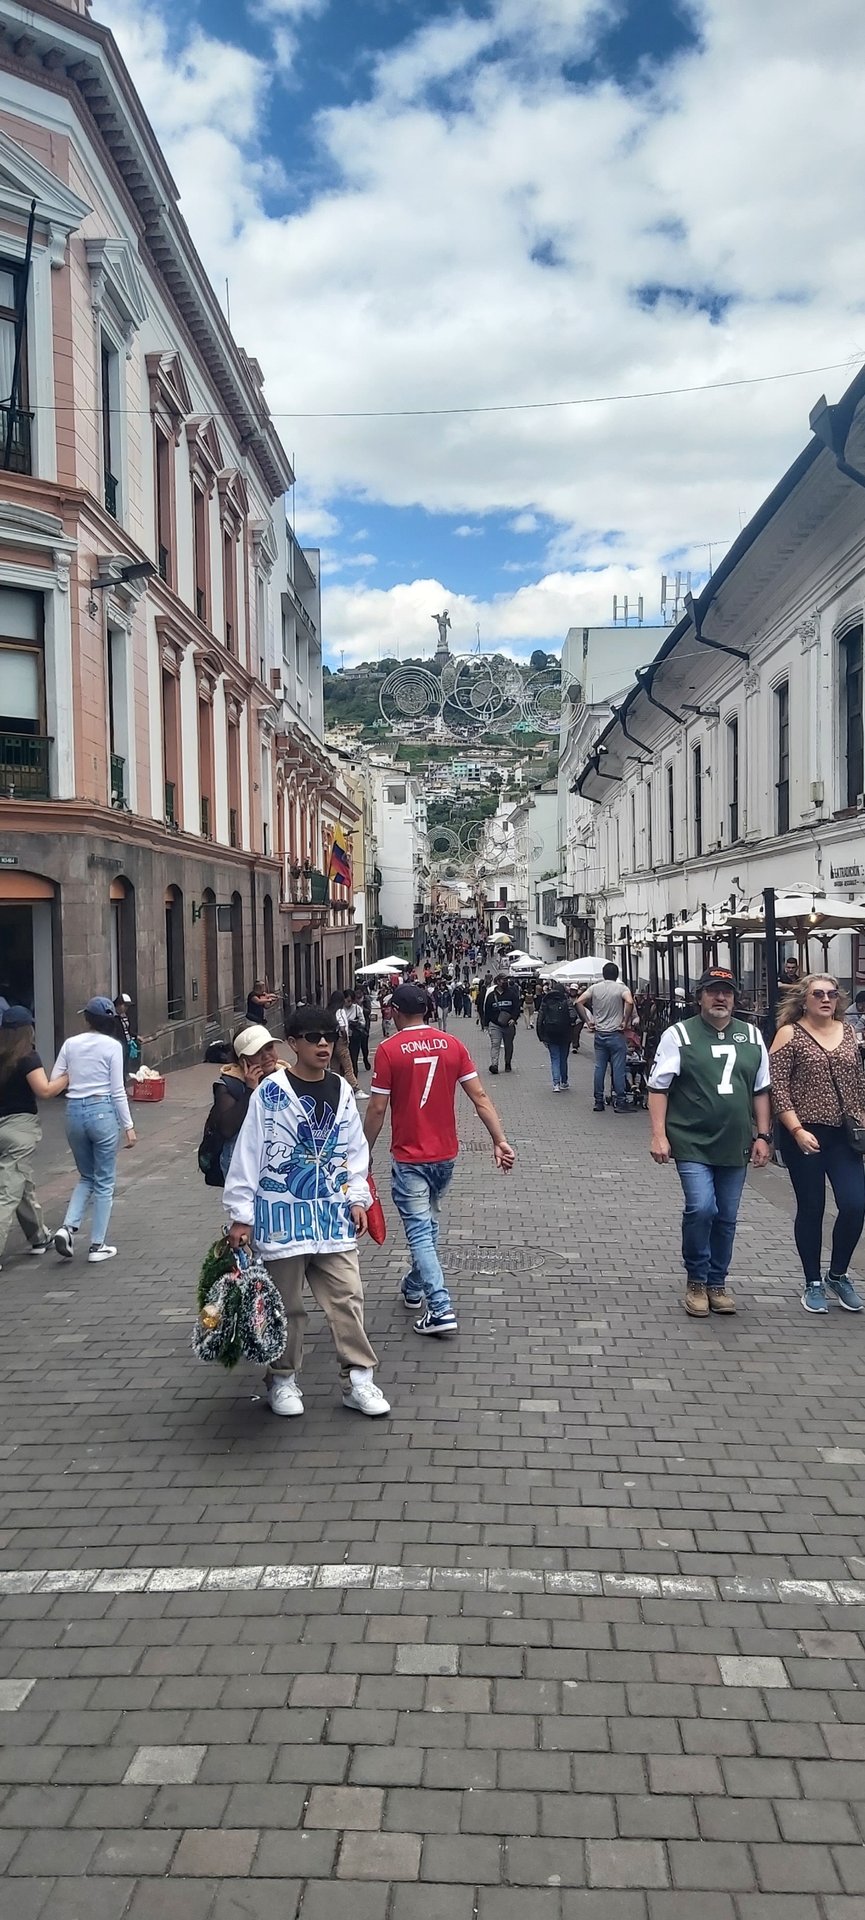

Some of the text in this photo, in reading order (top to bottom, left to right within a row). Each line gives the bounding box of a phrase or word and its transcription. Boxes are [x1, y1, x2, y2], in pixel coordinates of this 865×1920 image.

[400, 1039, 448, 1054] RONALDO
[710, 1044, 737, 1095] 7
[413, 1056, 439, 1109] 7
